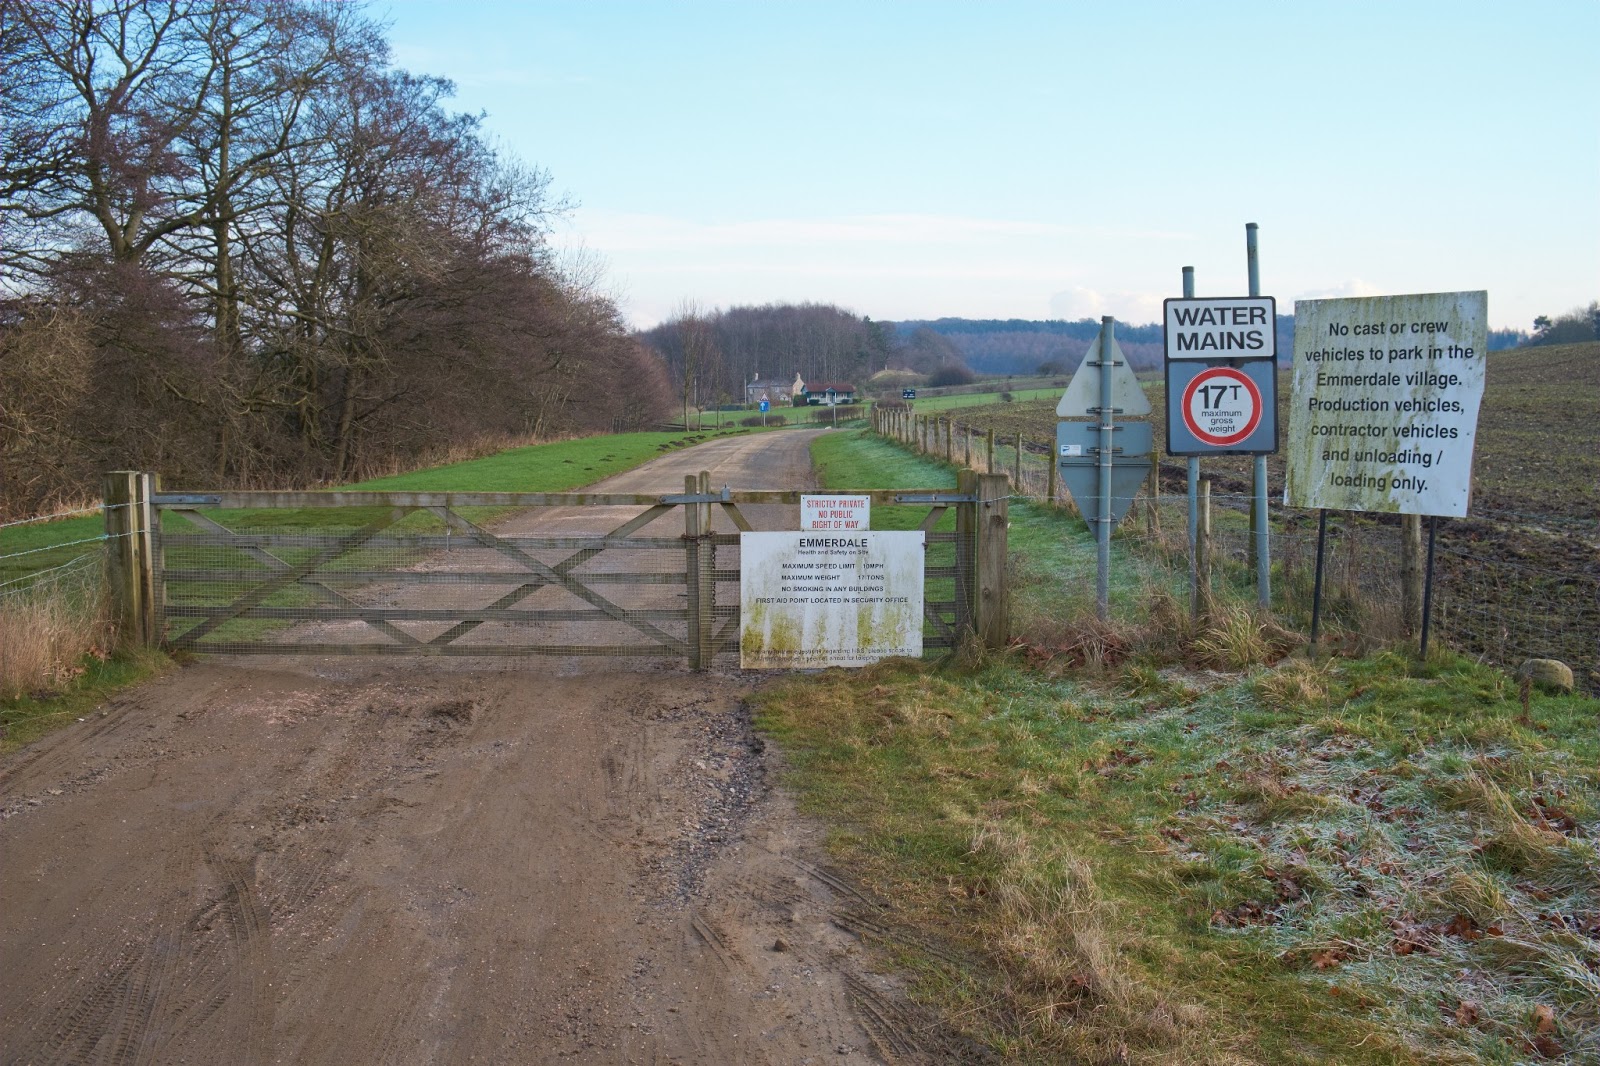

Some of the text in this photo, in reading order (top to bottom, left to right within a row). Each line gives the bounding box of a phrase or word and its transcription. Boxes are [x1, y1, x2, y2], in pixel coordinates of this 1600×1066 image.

[1173, 306, 1267, 326] WATER
[1329, 321, 1448, 336] No cast or crew
[1177, 330, 1264, 351] MAINS
[1305, 344, 1474, 363] vehicles to park in the
[1317, 371, 1463, 389] Emmerdale village.
[1201, 409, 1242, 417] maximum
[1308, 397, 1465, 415] Production vehicles,
[1208, 425, 1236, 433] weight
[1311, 423, 1458, 438] contractor vehicles
[1322, 448, 1349, 462] and
[1354, 448, 1432, 467] unloading
[1330, 472, 1428, 493] loading only.
[806, 499, 865, 508] STRICTLY PRIVATE
[818, 510, 853, 518] NO PUBLIC
[812, 520, 859, 529] RIGHT OF WAY
[799, 538, 868, 548] EMMERDALE
